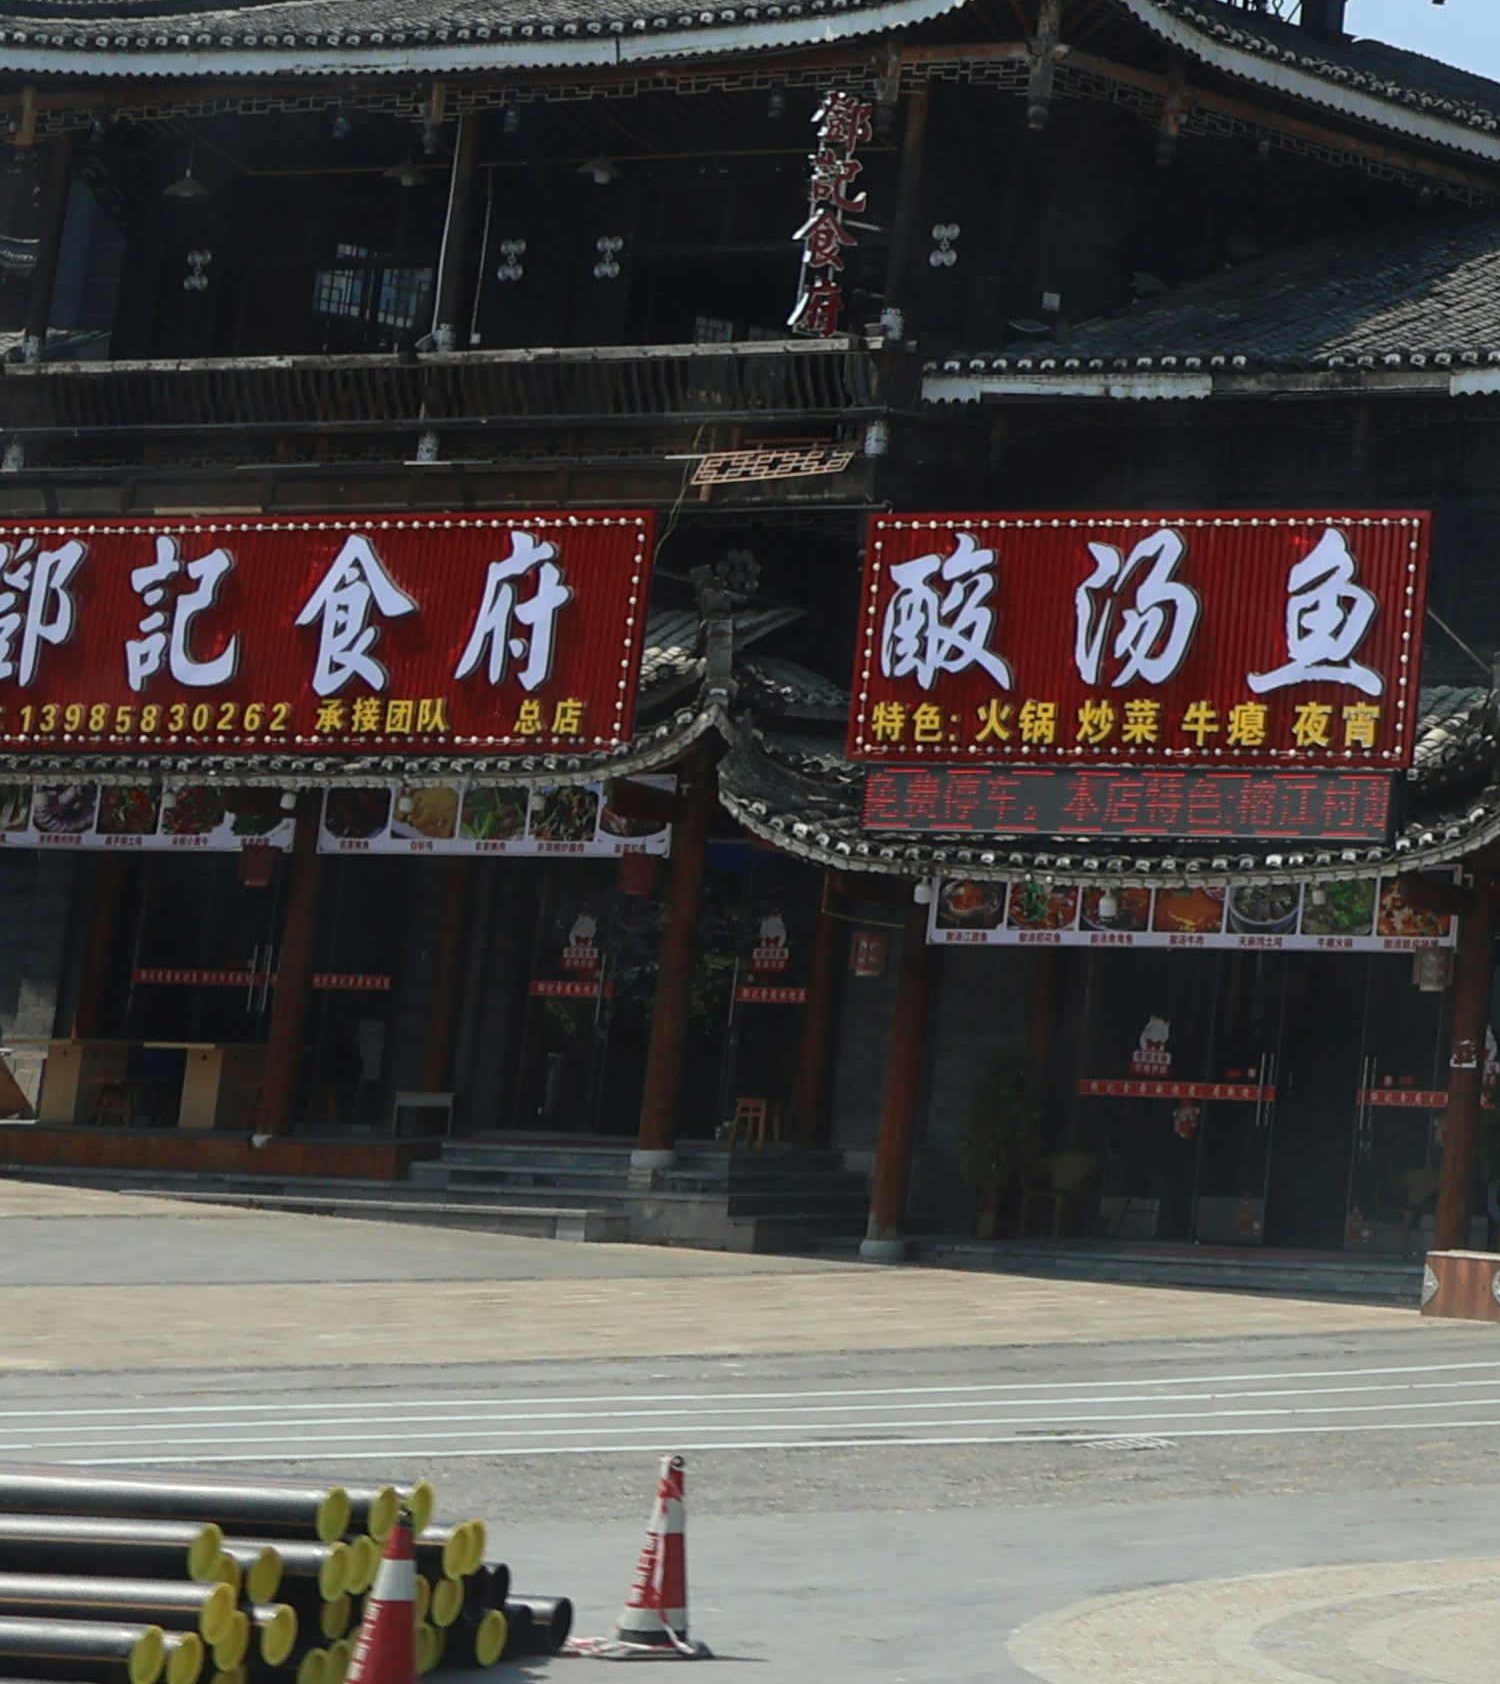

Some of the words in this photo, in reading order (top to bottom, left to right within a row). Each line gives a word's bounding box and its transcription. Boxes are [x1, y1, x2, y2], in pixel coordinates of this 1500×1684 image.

[880, 527, 1386, 696] 酸汤鱼
[20, 702, 290, 733] 13985830262
[315, 697, 448, 734] 承接团队
[513, 697, 585, 736] 总店
[975, 700, 1057, 744] 火锅
[1077, 700, 1162, 744] 炒菜
[1291, 702, 1382, 748] 夜宵
